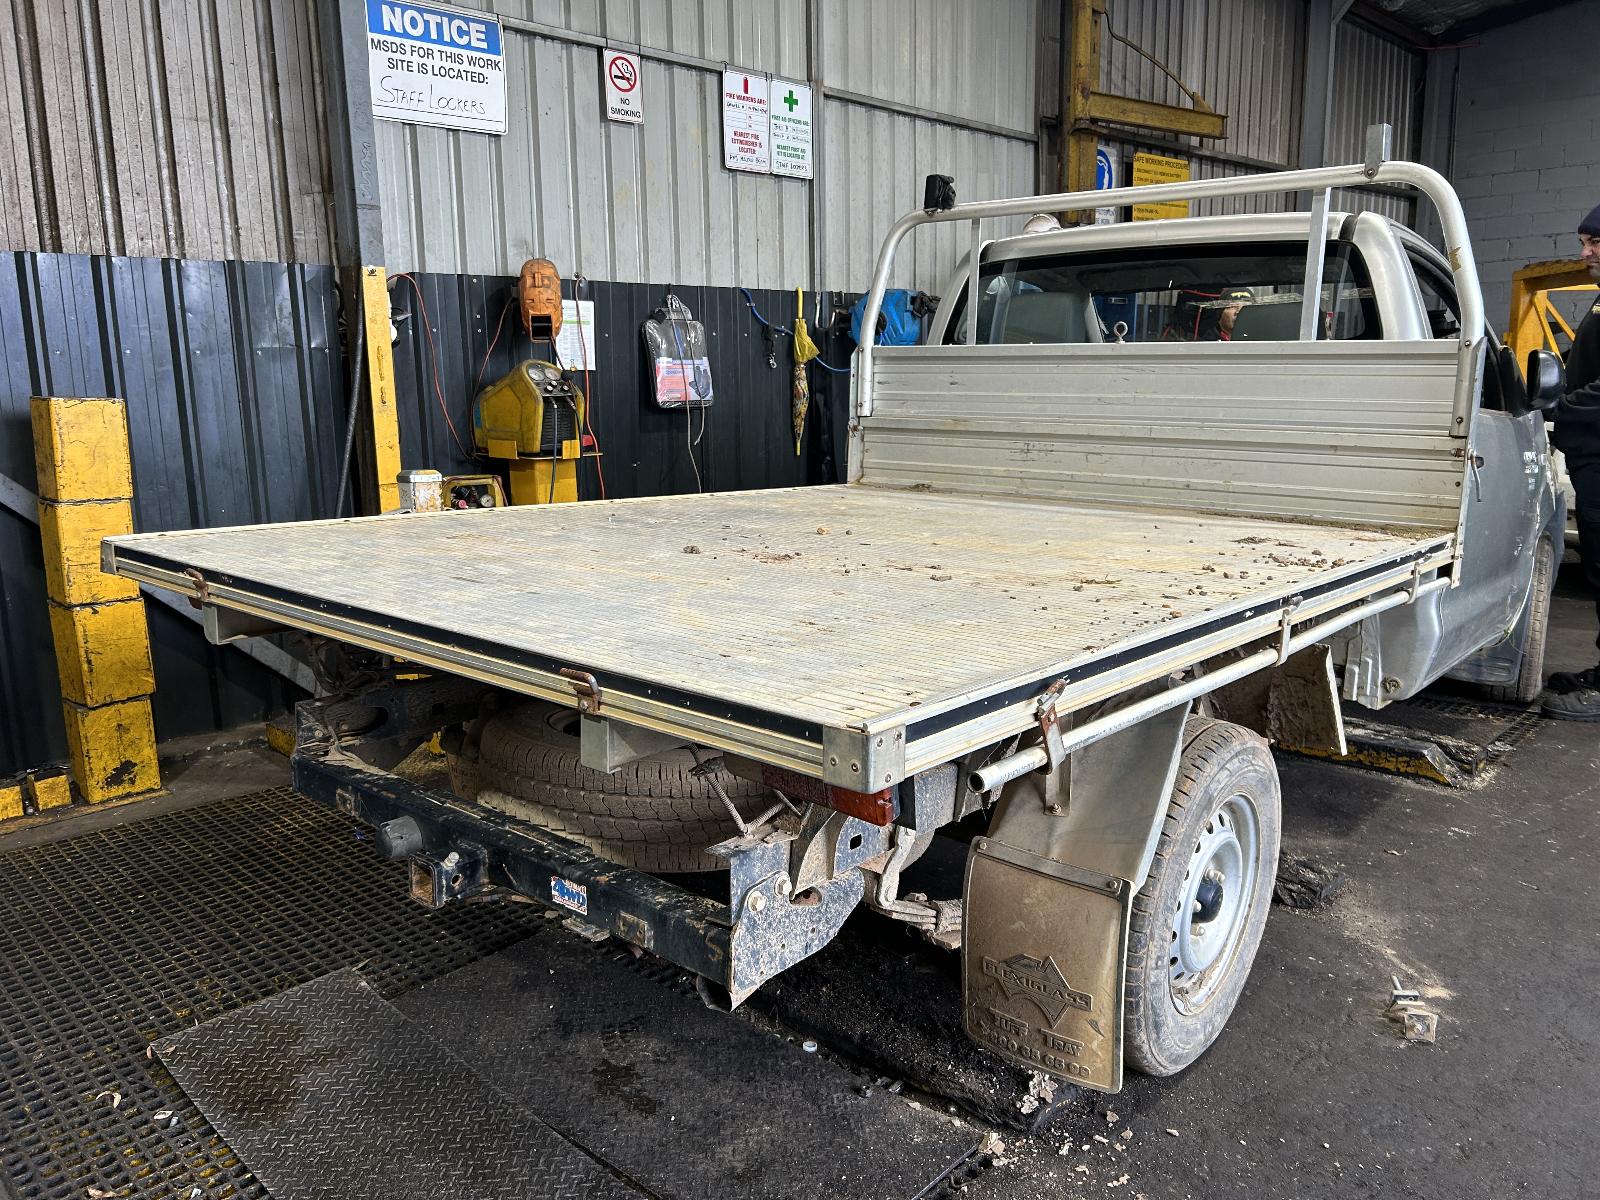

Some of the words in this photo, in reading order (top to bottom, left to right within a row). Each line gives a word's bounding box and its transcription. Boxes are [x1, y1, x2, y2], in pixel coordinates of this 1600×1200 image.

[381, 4, 488, 49] NOTICE
[370, 38, 407, 55] MSDS
[410, 45, 435, 60] FOR
[438, 49, 464, 65] THIS
[467, 54, 502, 71] WORK
[387, 58, 414, 73] SITE
[417, 62, 429, 75] IS
[431, 64, 489, 85] LOCATED:
[377, 75, 424, 108] STAFF
[429, 83, 486, 115] LOCKERS
[620, 97, 630, 106] NO
[725, 92, 735, 100] FIRE
[735, 94, 757, 104] WARDENS
[610, 106, 641, 119] SMOKING
[1133, 155, 1145, 164] SAFE
[1144, 157, 1165, 166] WORKING
[985, 961, 1090, 1007] FLEXIGLASS
[1040, 1028, 1085, 1056] TRAY
